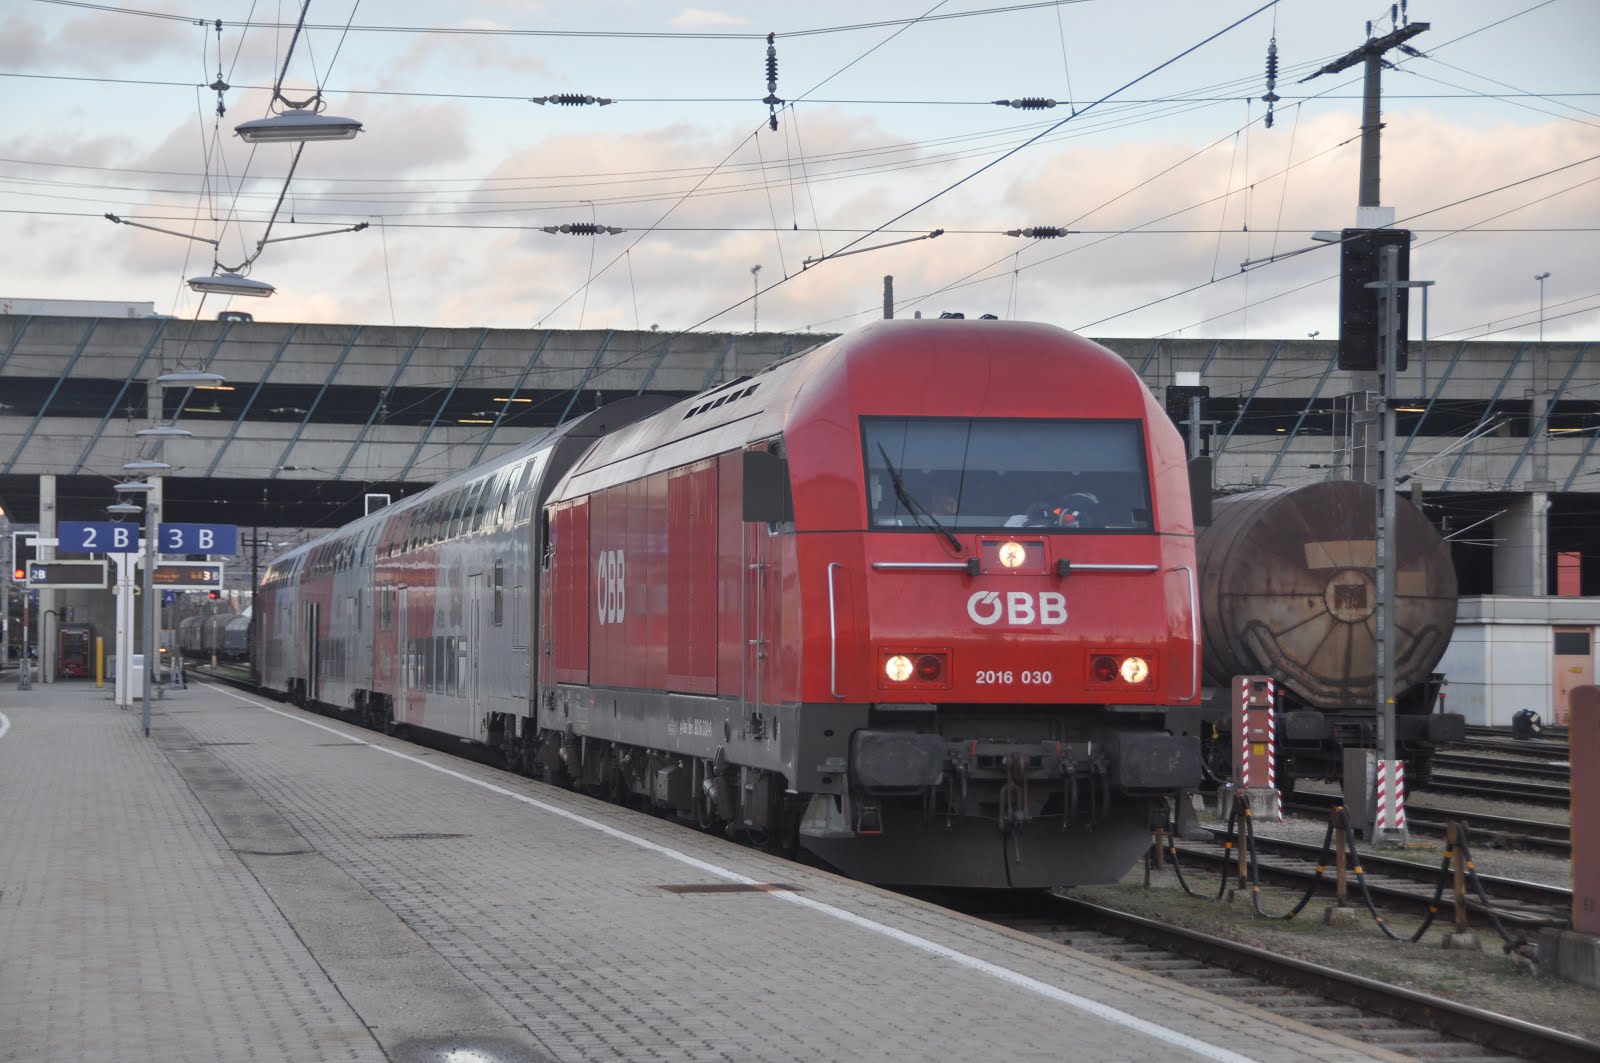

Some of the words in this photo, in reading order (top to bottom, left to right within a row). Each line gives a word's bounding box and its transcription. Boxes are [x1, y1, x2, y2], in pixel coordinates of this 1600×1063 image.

[82, 527, 97, 548] 2
[113, 527, 129, 547] B
[168, 529, 183, 549] 3
[199, 529, 214, 549] B
[597, 550, 625, 625] ÖBB
[967, 591, 1068, 625] ÖBB
[976, 671, 1013, 684] 2016
[1021, 671, 1052, 684] 030
